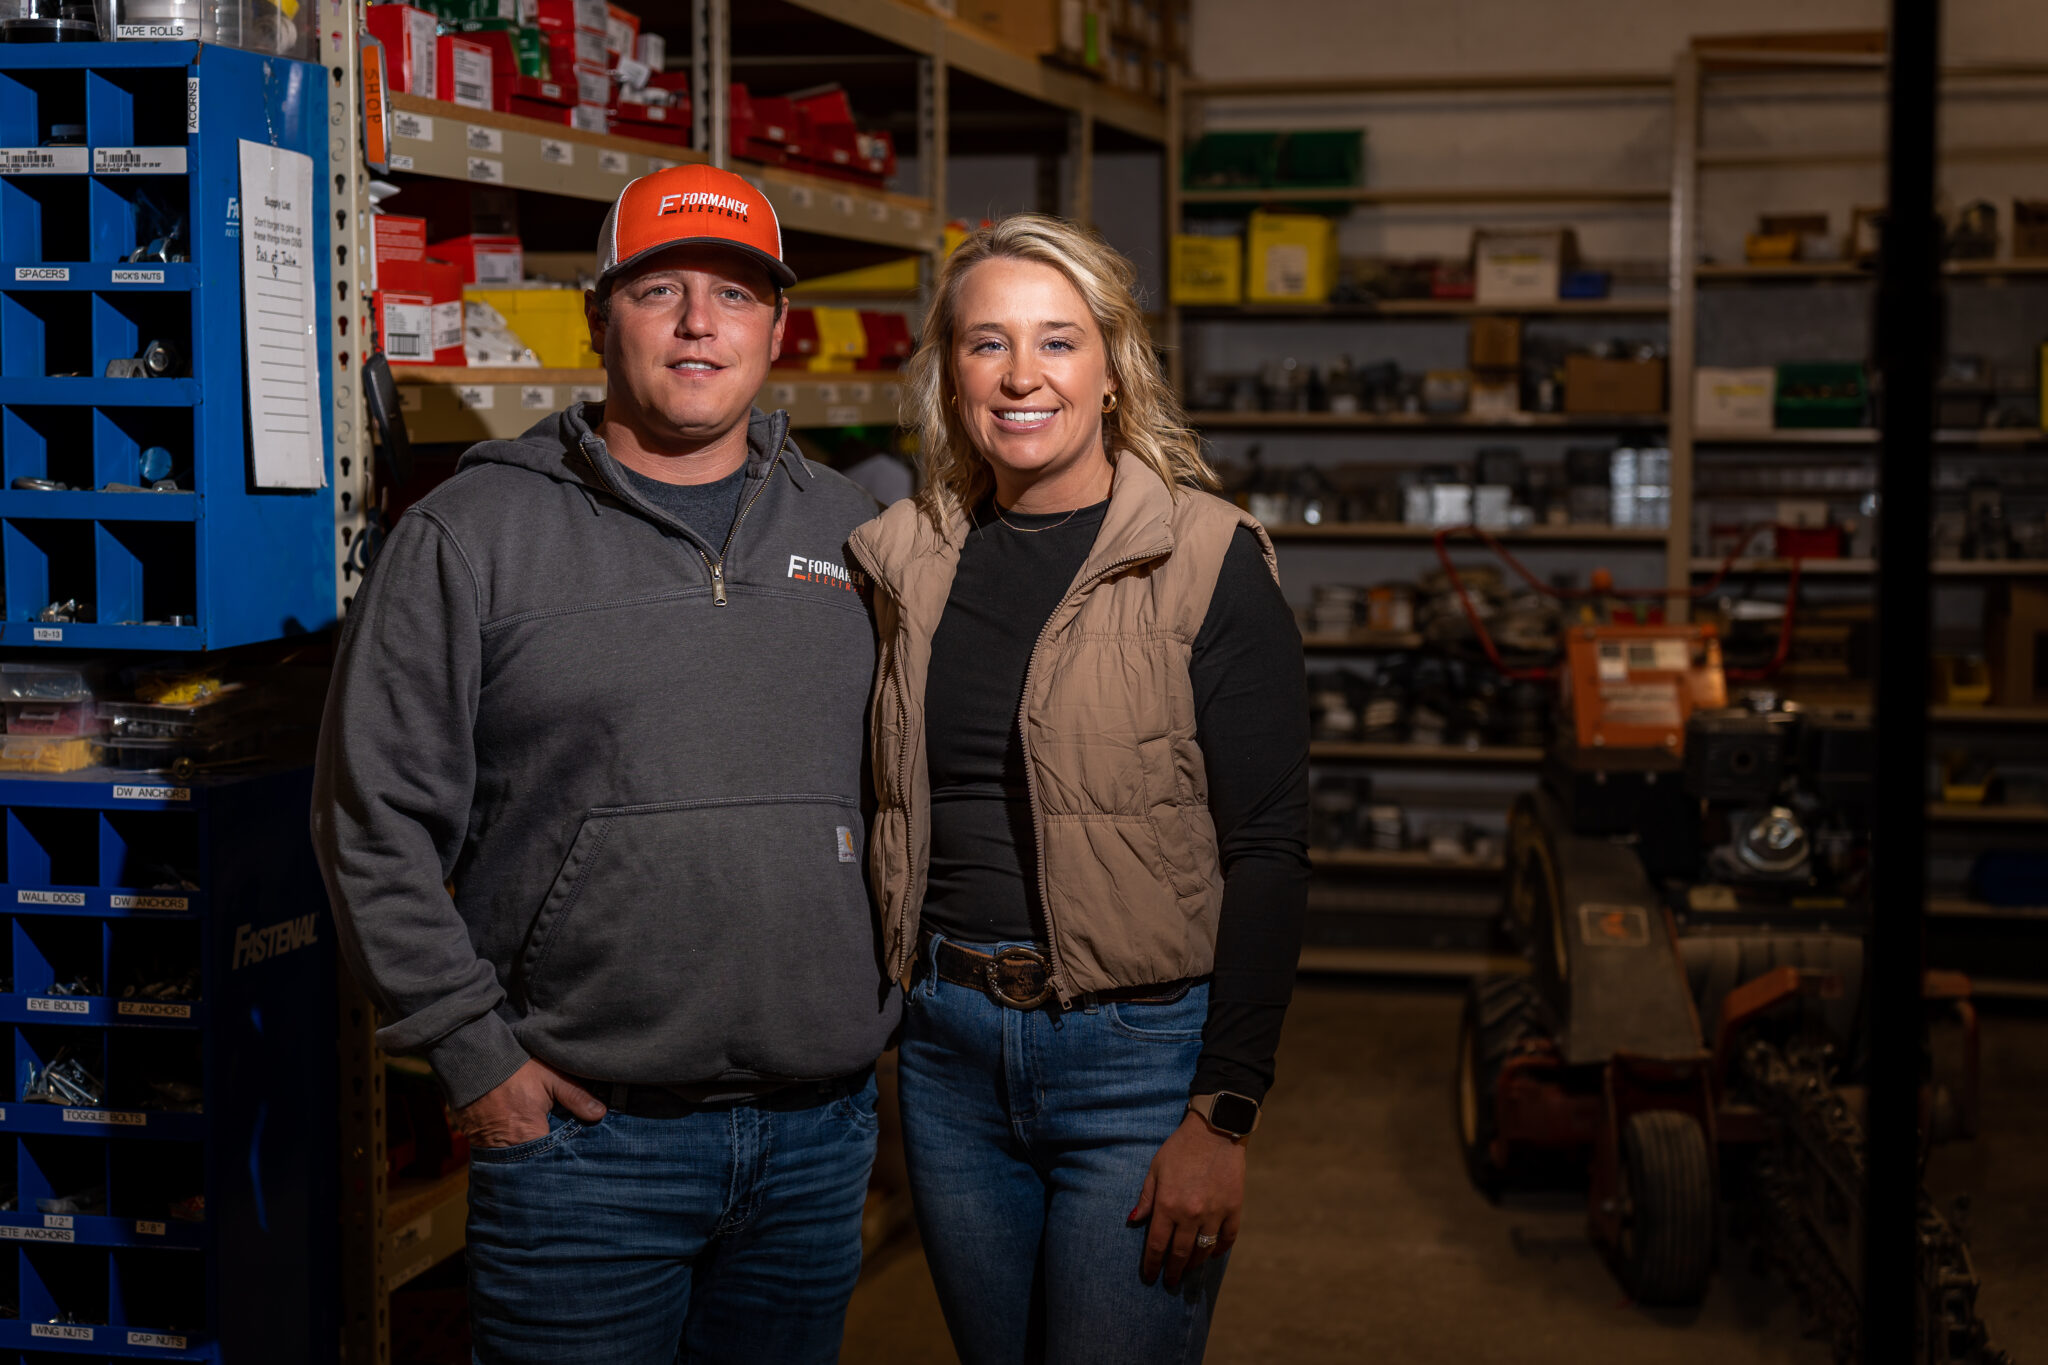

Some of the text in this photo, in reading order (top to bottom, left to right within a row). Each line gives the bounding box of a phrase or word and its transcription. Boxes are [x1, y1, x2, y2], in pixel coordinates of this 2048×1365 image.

[119, 26, 183, 36] TAPE ROLLS
[364, 69, 381, 123] SHOP
[188, 81, 197, 129] ACORNS
[681, 192, 749, 215] FORMANEK
[679, 205, 748, 223] ELECTRIC
[19, 269, 66, 279] SPACERS
[115, 272, 162, 281] NICK'S NUTS
[808, 559, 865, 587] FORMANEK
[116, 787, 187, 799] DW ANCHORS
[22, 892, 82, 904] WALL DOGS
[114, 896, 184, 909] DW ANCHORS
[232, 912, 319, 972] FASTENAL
[31, 999, 85, 1011] EYE BOLTS
[121, 1003, 188, 1016] EZ ANCHORS
[66, 1111, 142, 1123] TOGGLE BOLTS
[24, 1228, 71, 1240] ANCHORS
[34, 1325, 90, 1339] WING NUTS
[130, 1333, 184, 1347] CAP NUTS
